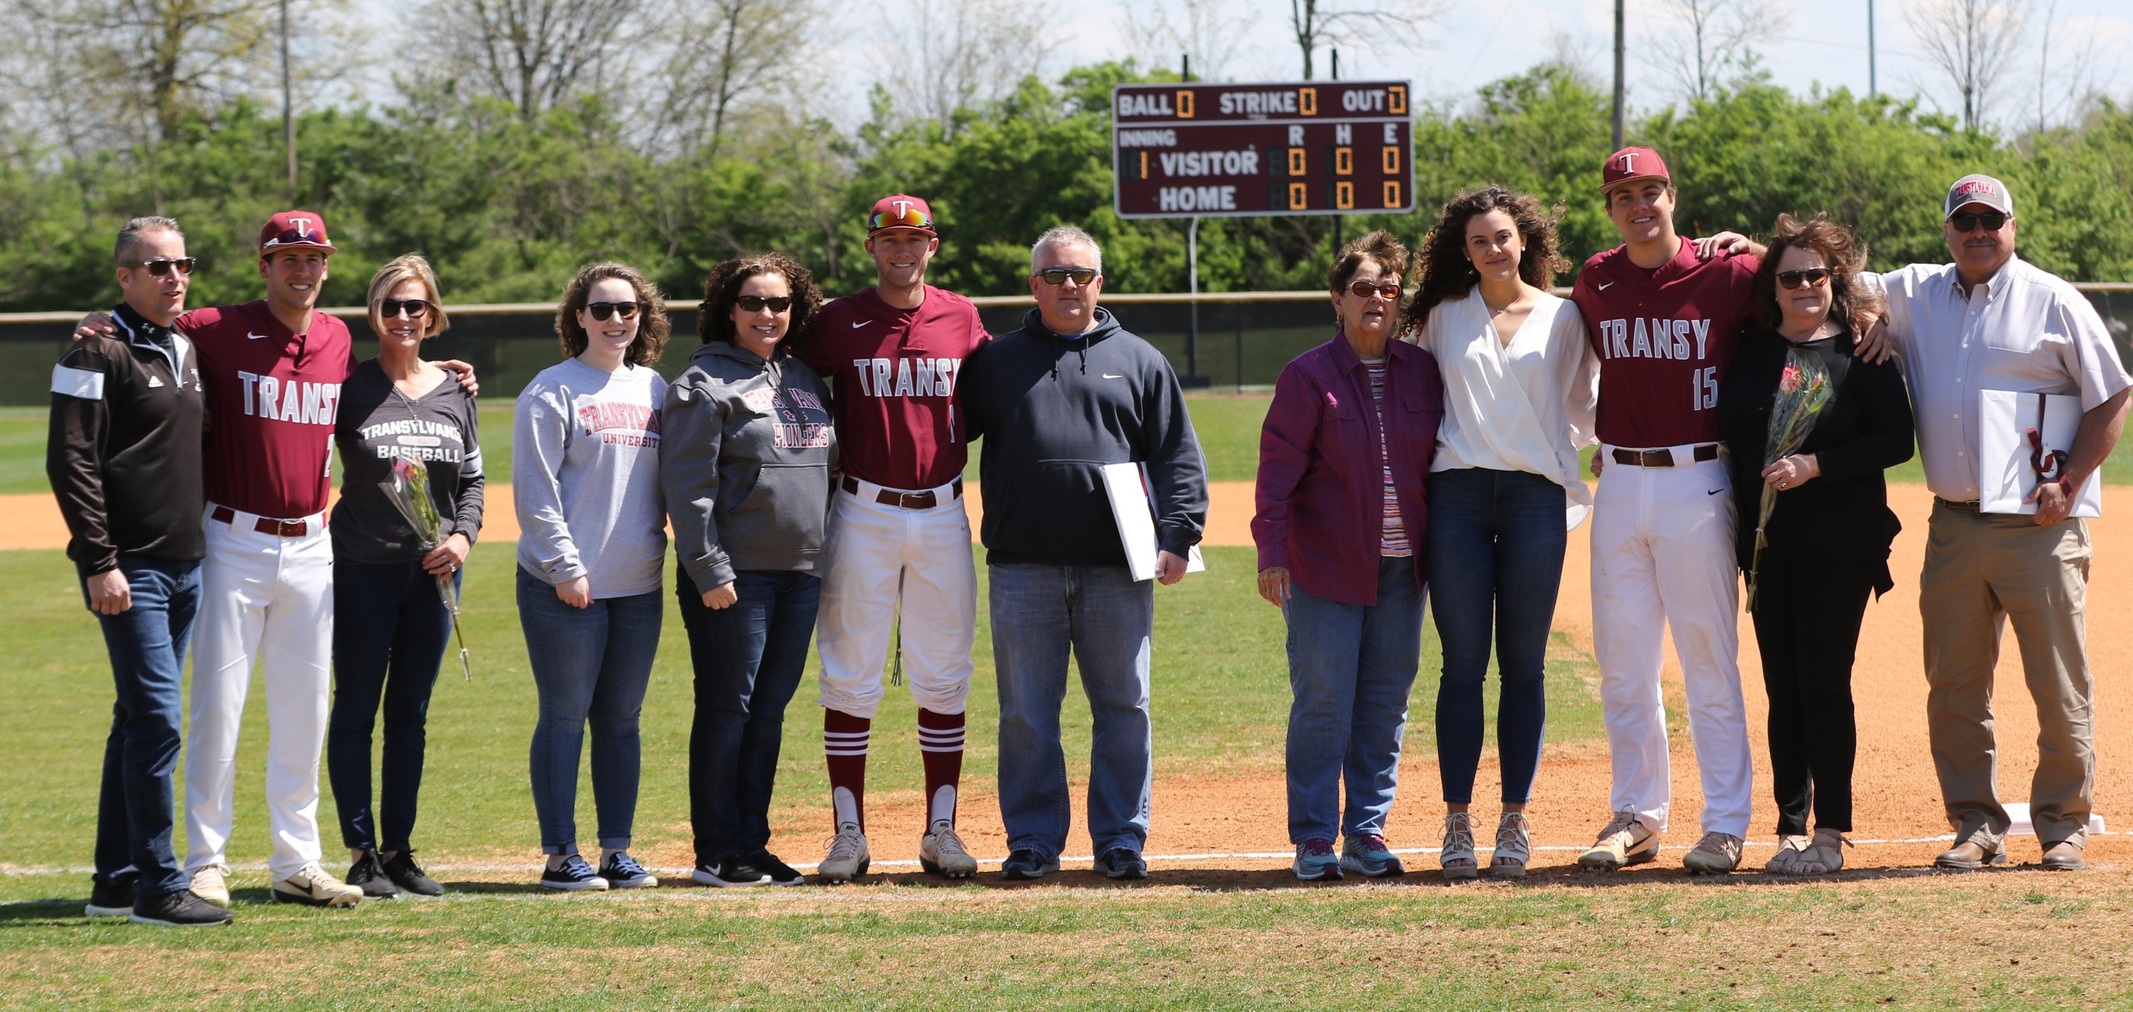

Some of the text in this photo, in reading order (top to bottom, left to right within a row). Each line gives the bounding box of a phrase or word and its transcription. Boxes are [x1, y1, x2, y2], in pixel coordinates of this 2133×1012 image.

[1118, 94, 1173, 116] BALL
[1176, 89, 1195, 118] 0
[1219, 91, 1297, 114] STRIKE
[1299, 87, 1317, 116] 0
[1342, 89, 1385, 112] OUT
[1119, 122, 1398, 147] INNING R H E
[1160, 150, 1259, 176] VISITOR
[1288, 147, 1306, 176] 0
[1335, 147, 1353, 175] 0
[1382, 146, 1400, 174] 0
[1619, 153, 1640, 175] T
[892, 200, 914, 219] T
[1160, 180, 1401, 211] HOME 0 0 0
[289, 218, 312, 237] T
[1600, 317, 1711, 360] TRANSY
[237, 370, 343, 425] TRANS
[1692, 366, 1718, 411] 15
[377, 445, 461, 463] BASEBALL
